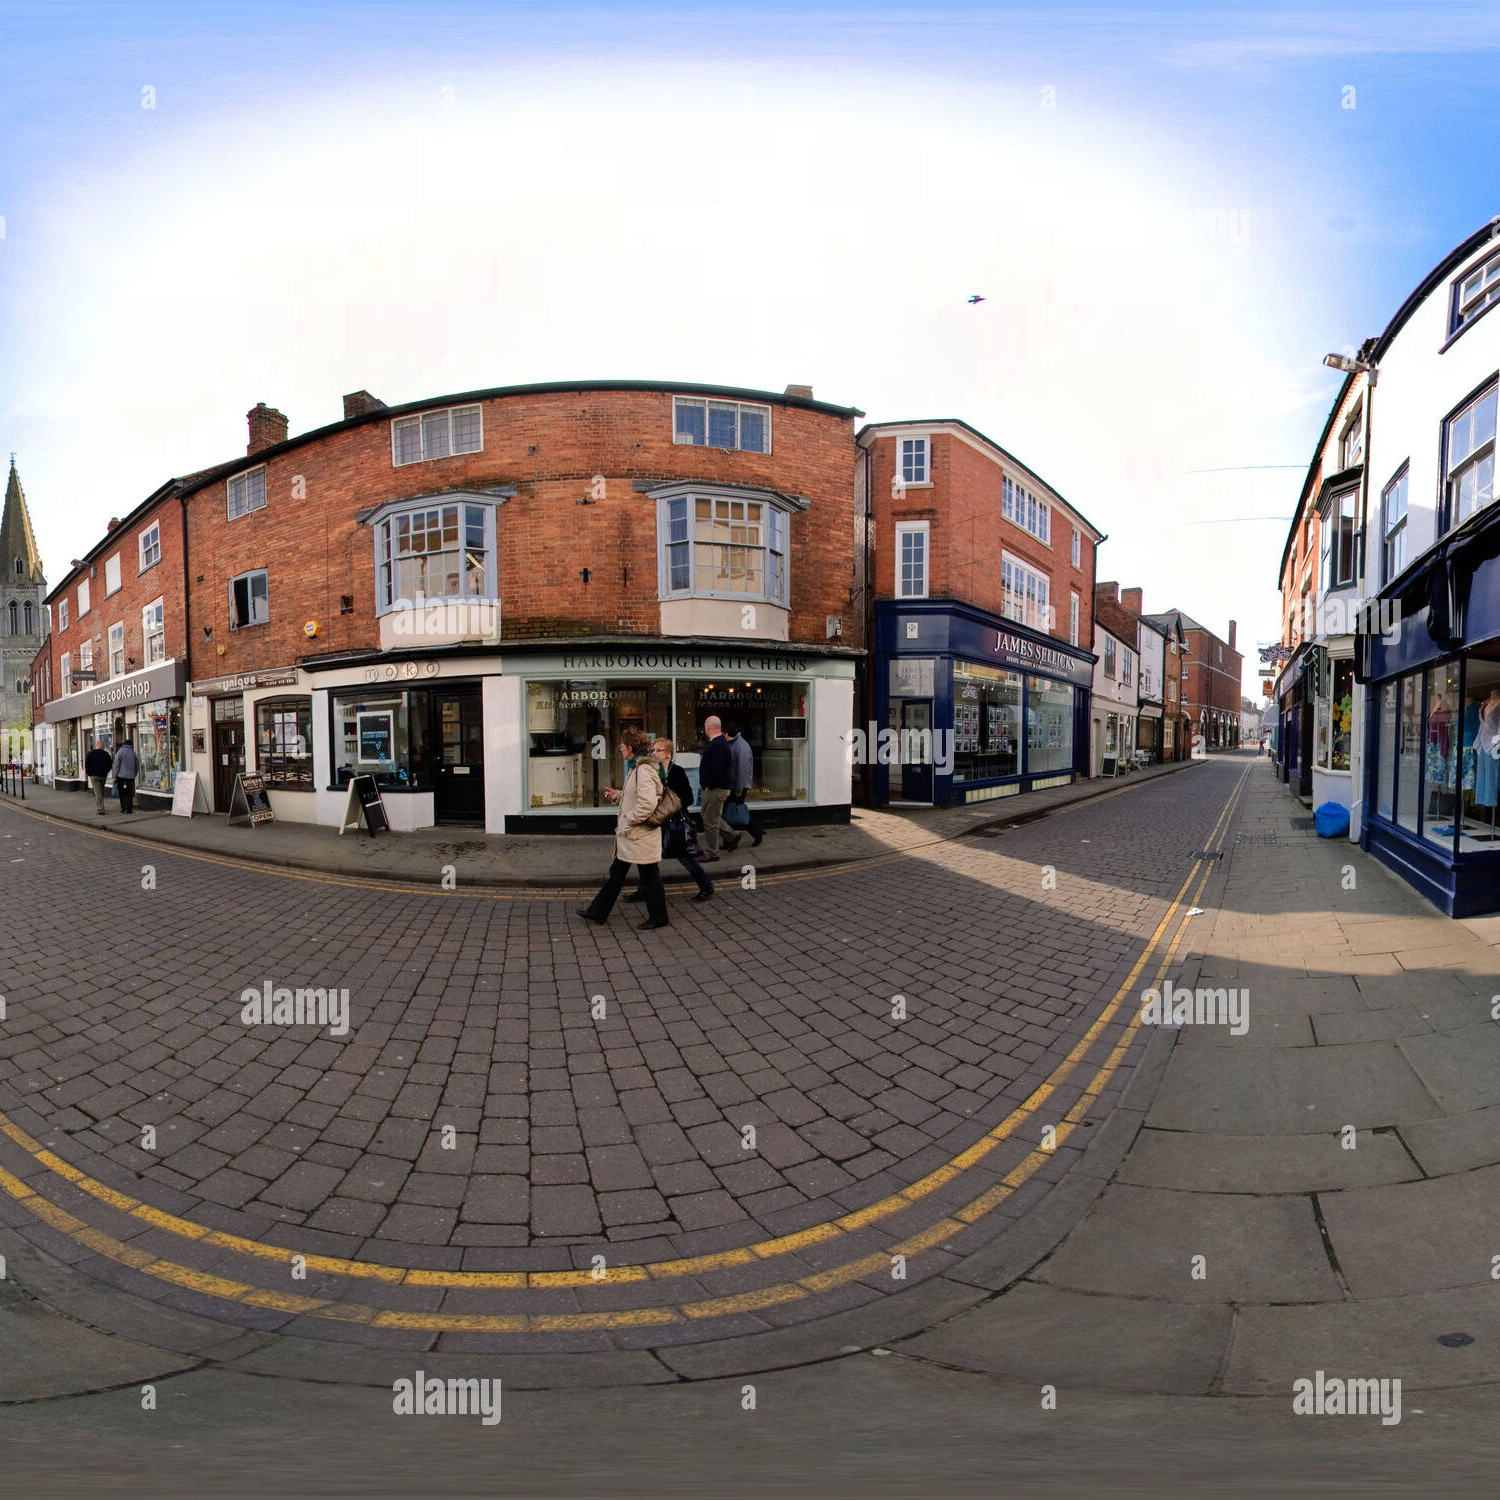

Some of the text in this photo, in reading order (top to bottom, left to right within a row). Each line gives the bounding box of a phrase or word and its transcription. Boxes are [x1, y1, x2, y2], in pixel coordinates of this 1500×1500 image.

[994, 631, 1075, 671] JAMES SELLICKS
[563, 654, 807, 671] HARBOROUGH KITCHENS
[222, 676, 256, 692] Unique
[93, 679, 151, 707] the cookshop
[253, 812, 272, 821] OPEN
